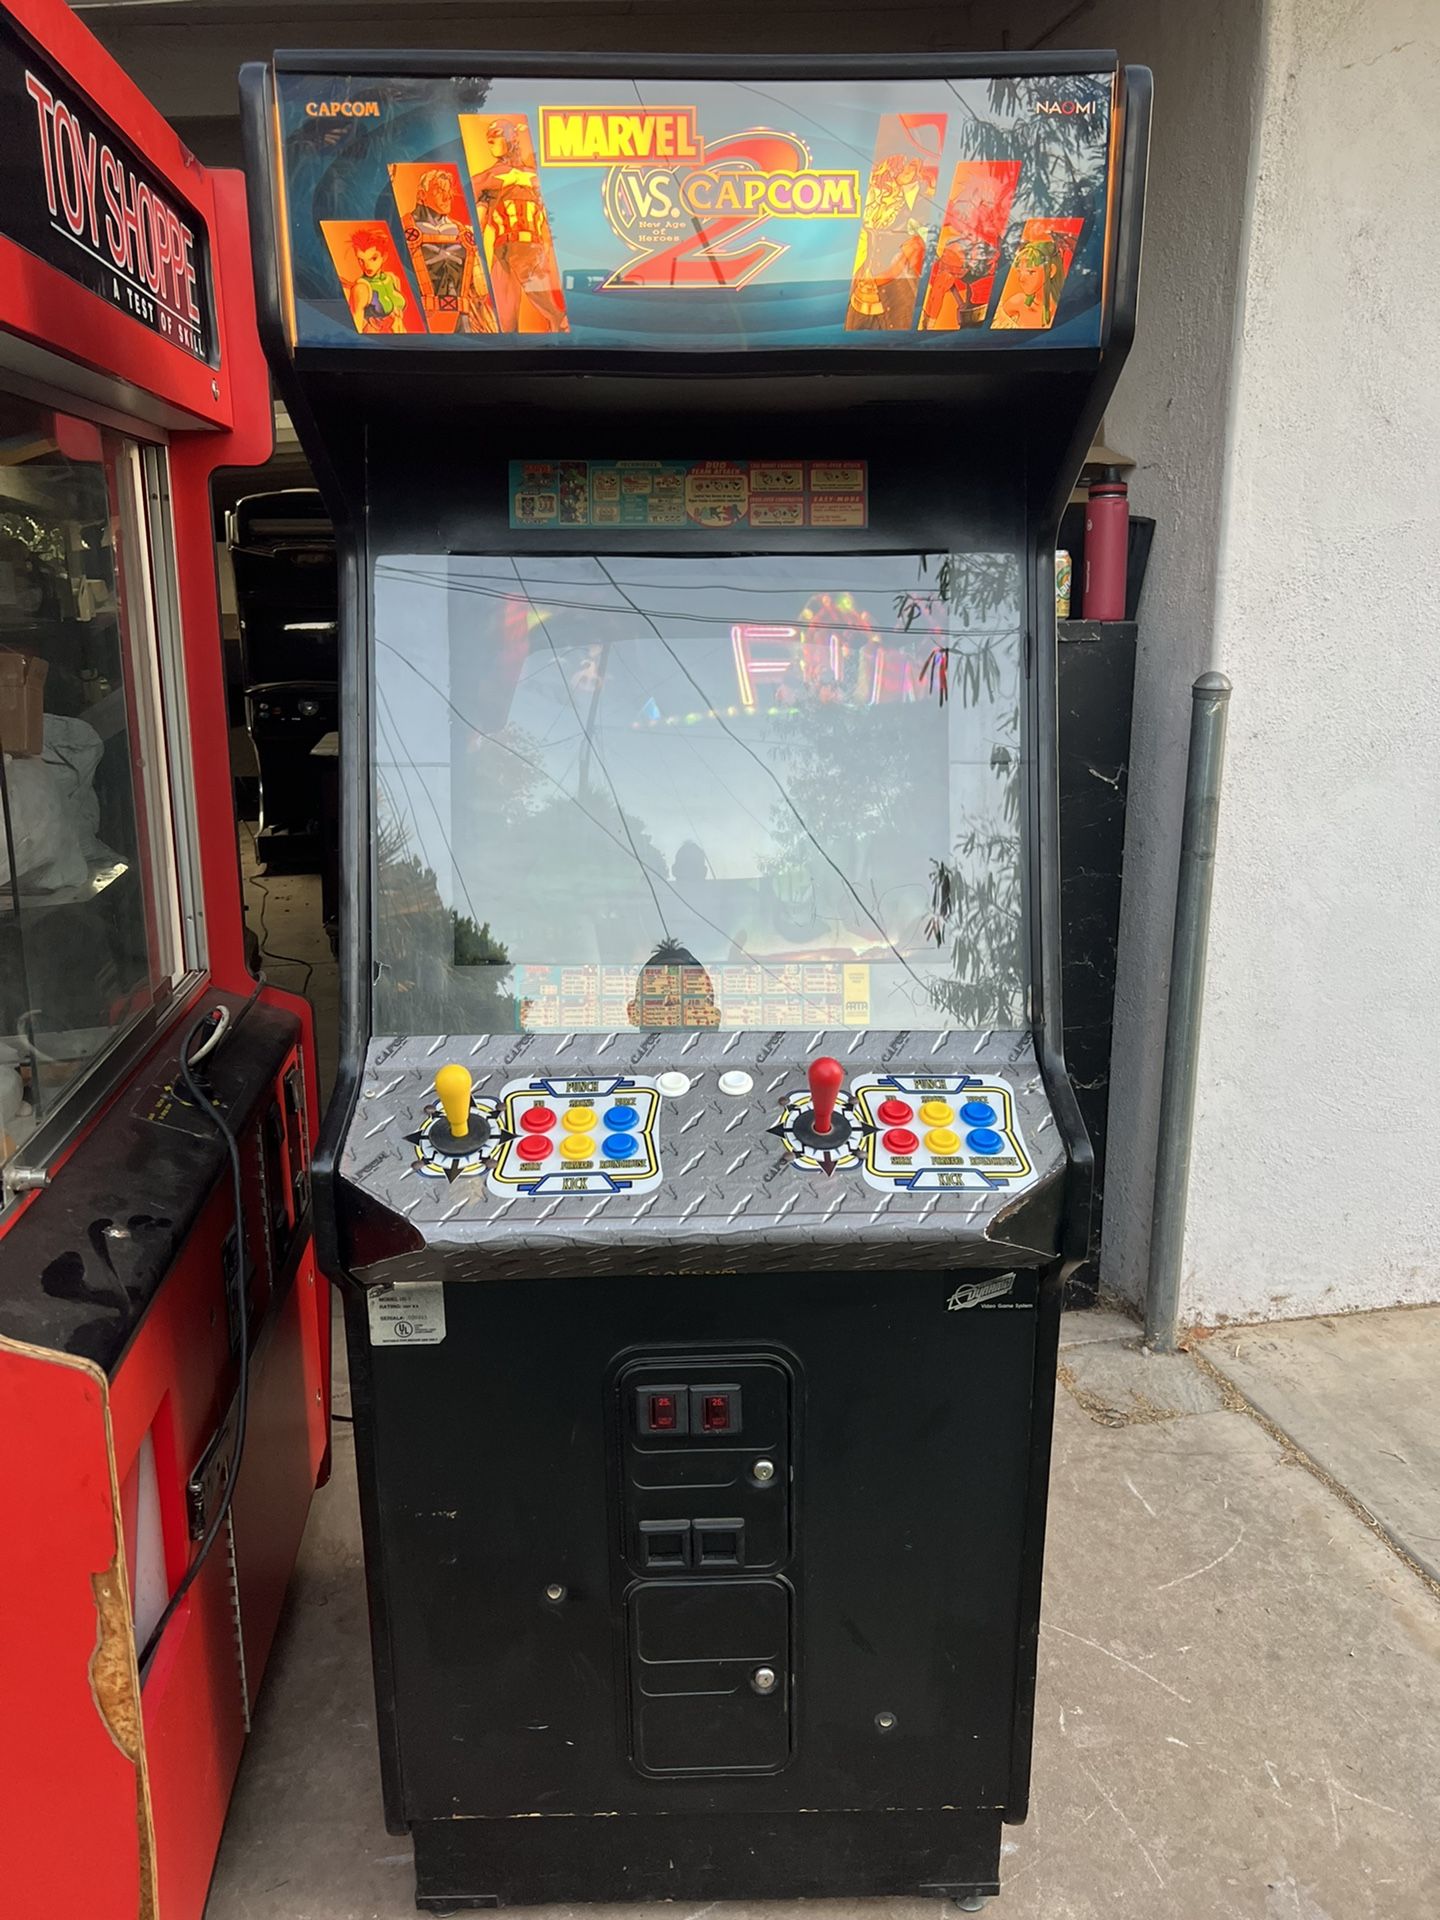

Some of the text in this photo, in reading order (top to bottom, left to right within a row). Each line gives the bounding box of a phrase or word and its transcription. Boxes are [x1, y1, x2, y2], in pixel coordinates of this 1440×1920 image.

[305, 101, 380, 117] CAPCOM
[1035, 100, 1096, 115] NAOMI
[546, 114, 697, 158] MARVEL
[25, 69, 201, 325] TOY SHOPPE
[627, 174, 855, 218] VS. CAPCOM
[639, 221, 686, 229] New Age
[652, 228, 666, 236] of
[113, 277, 205, 358] A TEST OF SKILL
[375, 1034, 408, 1066] CAPCO
[505, 1034, 535, 1065] CAPCO
[631, 1033, 661, 1064] CAPCO
[756, 1031, 786, 1063] CAPCO
[881, 1031, 911, 1063] CAPCO
[1008, 1031, 1033, 1063] CAPCO
[565, 1081, 599, 1093] PUNCH
[913, 1078, 947, 1089] PUNCH
[560, 1160, 594, 1170] FORWARD
[599, 1158, 647, 1169] ROUNDHOUSE
[930, 1156, 964, 1165] FORWARD
[968, 1156, 1019, 1166] ROUNDHOUSE
[561, 1177, 588, 1190] KICK
[936, 1173, 964, 1186] KICK
